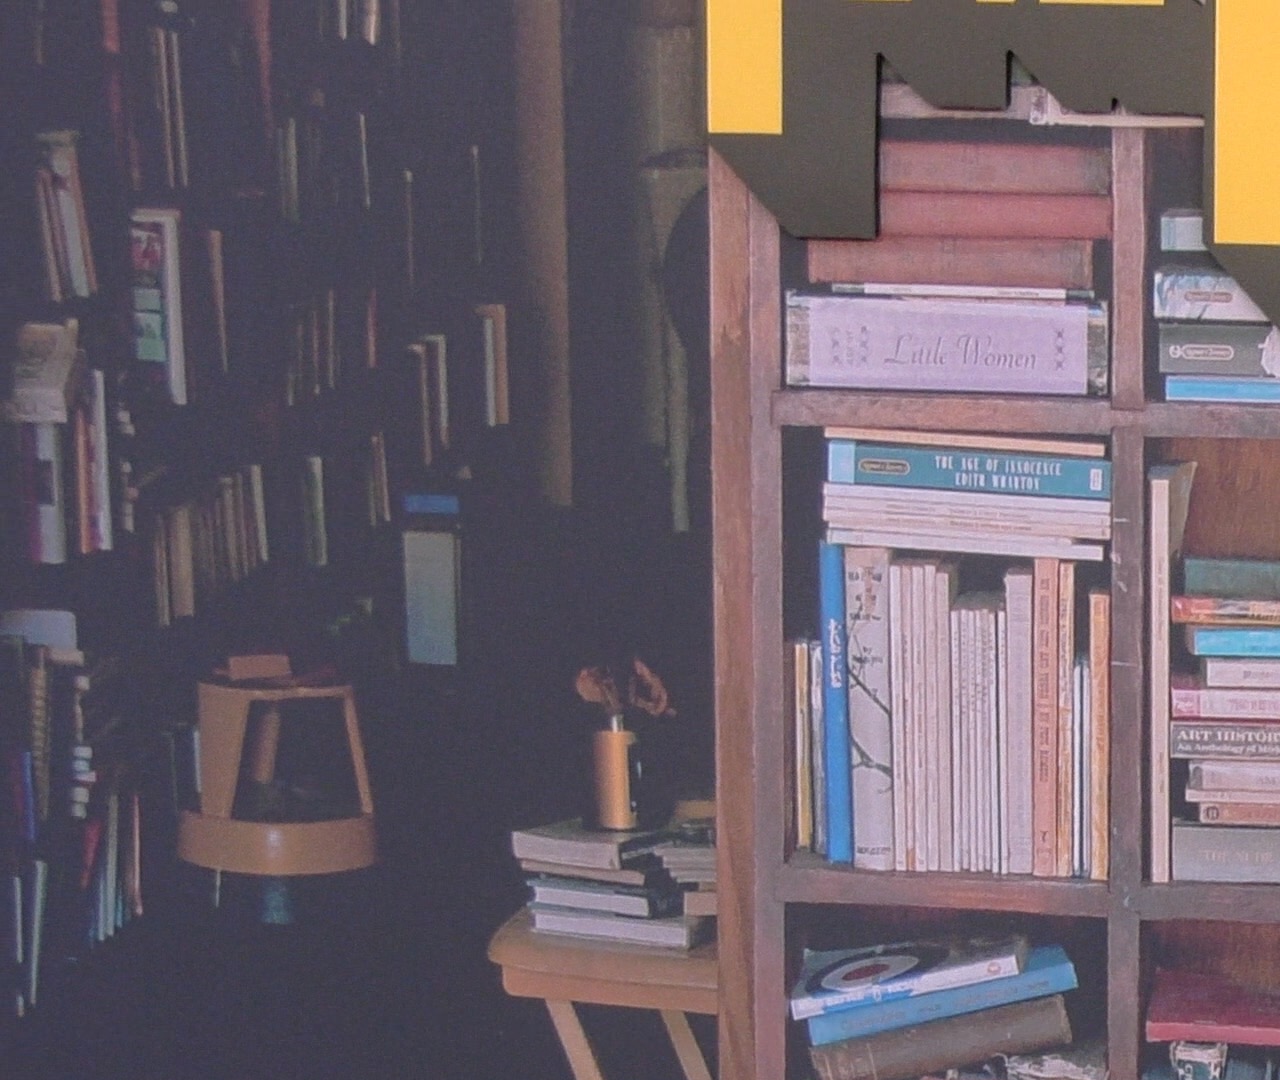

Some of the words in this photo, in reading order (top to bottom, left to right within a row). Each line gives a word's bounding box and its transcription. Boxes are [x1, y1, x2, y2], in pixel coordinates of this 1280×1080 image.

[883, 333, 948, 367] Little
[956, 334, 1038, 370] Women
[934, 455, 954, 470] THE
[961, 457, 981, 472] AGE
[985, 457, 999, 473] OF
[1004, 460, 1062, 477] INNOCENCE
[955, 472, 987, 488] EDITH
[991, 473, 1041, 491] WHARTON
[1177, 730, 1212, 743] ART
[1177, 743, 1192, 752] An
[1194, 743, 1239, 755] Anthology
